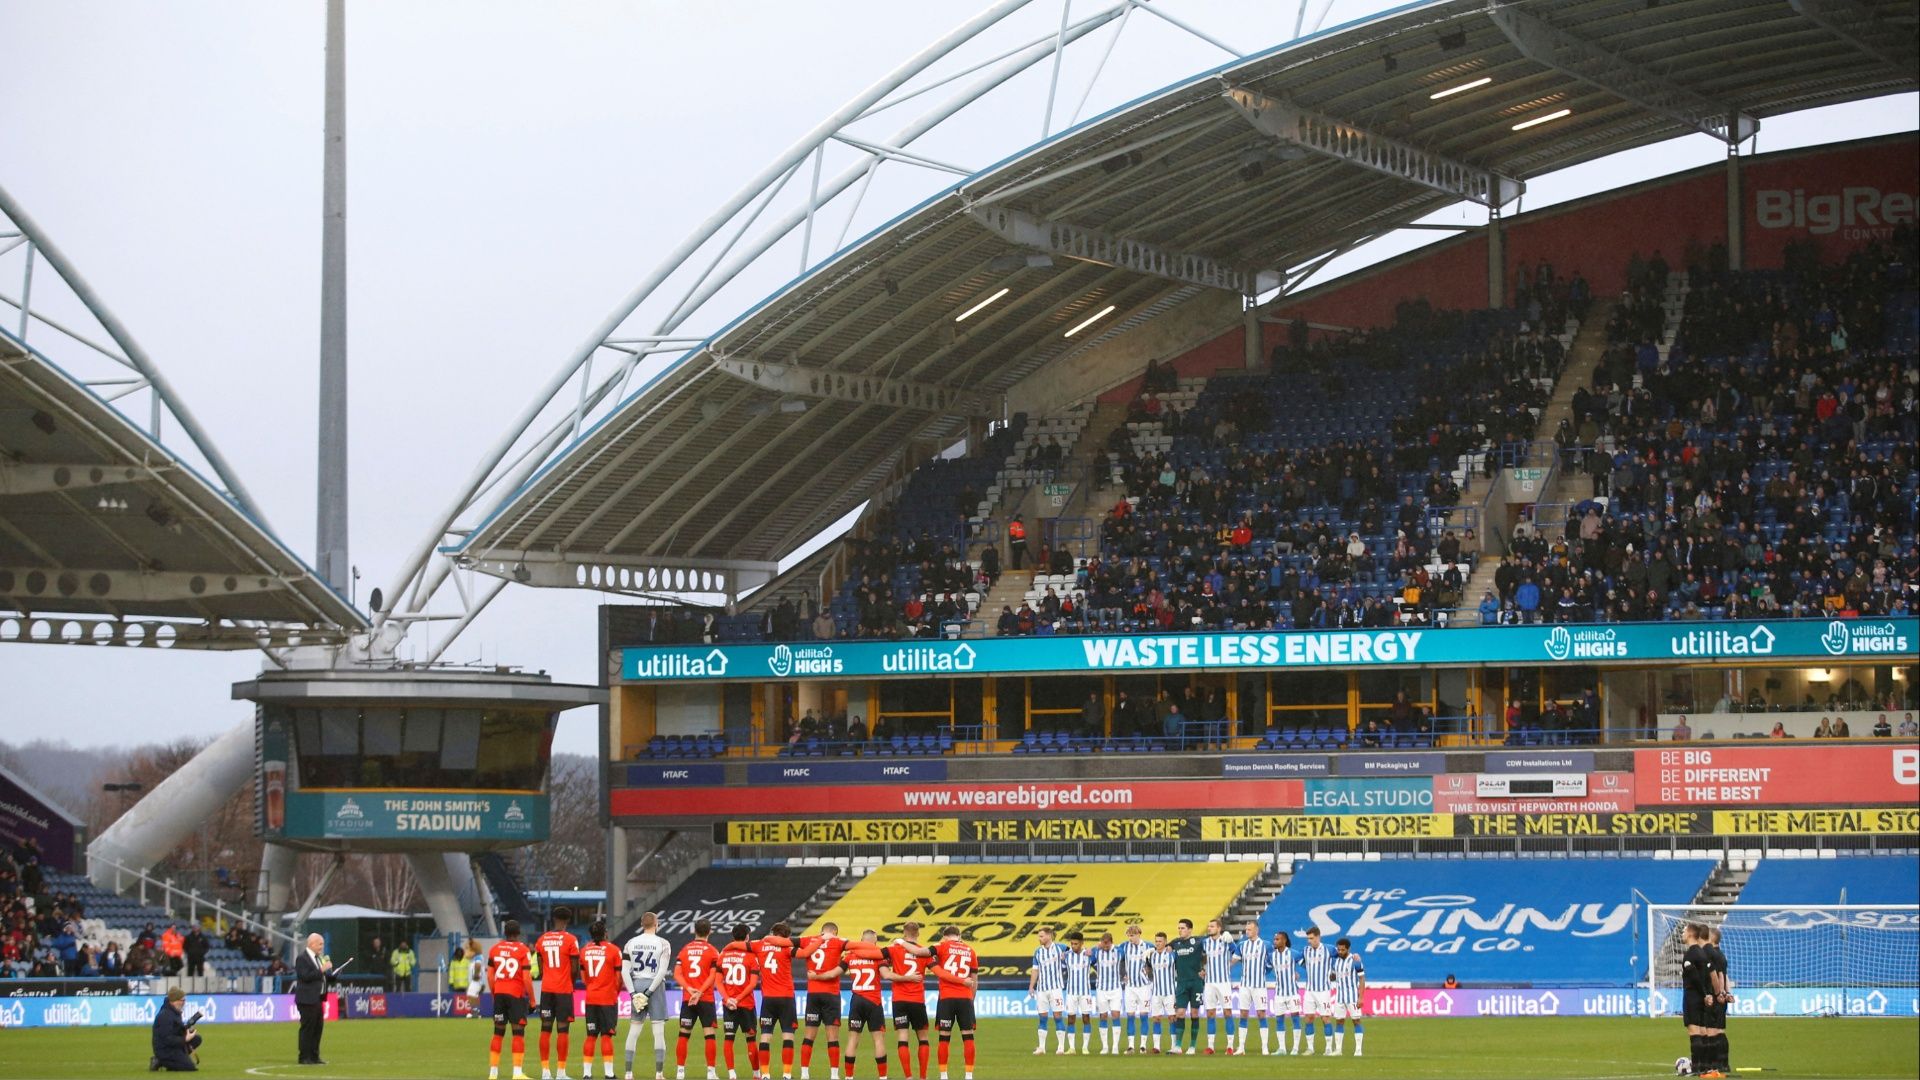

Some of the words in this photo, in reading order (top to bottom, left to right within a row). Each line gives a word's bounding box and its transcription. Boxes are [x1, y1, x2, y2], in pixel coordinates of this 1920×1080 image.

[1756, 186, 1918, 234] BigRe
[1574, 631, 1606, 641] utilita
[1852, 626, 1884, 636] utilita
[1082, 637, 1198, 667] WASTE
[1204, 636, 1280, 665] LESS
[1285, 632, 1422, 664] ENERGY
[1574, 642, 1613, 657] HIGH
[1617, 642, 1628, 656] 5
[1671, 630, 1750, 655] utilita
[1852, 637, 1893, 651] HIGH
[1895, 636, 1907, 650] 5
[795, 649, 824, 659] utilita
[883, 649, 951, 672] utilita
[638, 654, 706, 677] utilita
[795, 661, 832, 673] HIGH
[834, 659, 843, 672] 5
[1225, 763, 1251, 772] Simpson
[1275, 763, 1298, 772] Roofing
[1299, 762, 1325, 771] Services
[1376, 762, 1406, 771] Packaging
[1522, 759, 1561, 767] Installations
[1661, 752, 1681, 765] BE
[1684, 751, 1712, 765] BIG
[662, 770, 689, 779] HTAFC
[783, 768, 810, 777] HTAFC
[883, 766, 910, 776] HTAFC
[1661, 769, 1681, 783] BE
[1684, 767, 1771, 783] DIFFERENT
[904, 785, 1133, 808] www.wearebigred.com
[1304, 790, 1360, 807] LEGAL
[1364, 789, 1433, 806] STUDIO
[1661, 787, 1681, 801] BE
[1684, 787, 1717, 801] THE
[1720, 786, 1762, 800] BEST
[384, 800, 408, 811] THE
[410, 800, 442, 811] JOHN
[445, 801, 491, 812] SMITH'S
[1448, 803, 1473, 812] TIME
[1475, 803, 1489, 812] TO
[1490, 802, 1517, 812] VISIT
[1519, 801, 1578, 811] HEPWORTH
[1580, 801, 1618, 811] HONDA
[396, 813, 481, 831] STADIUM
[736, 823, 780, 843] THE
[787, 822, 861, 842] METAL
[973, 820, 1017, 841] THE
[1024, 819, 1102, 841] METAL
[1217, 818, 1263, 838] THE
[1271, 817, 1350, 837] METAL
[1469, 814, 1517, 836] THE
[1524, 814, 1607, 835] METAL
[1729, 813, 1779, 833] THE
[1787, 812, 1871, 833] METAL
[936, 873, 1077, 894] THE
[1342, 888, 1407, 901] The
[897, 896, 1141, 918] METAL
[494, 956, 519, 978] 29
[544, 946, 560, 968] 11
[584, 955, 606, 977] 17
[632, 951, 658, 973] 34
[688, 956, 701, 978] 3
[764, 952, 778, 974] 4
[811, 948, 825, 970] 9
[943, 955, 971, 978] 45
[722, 963, 746, 986] 20
[850, 968, 875, 990] 22
[904, 959, 918, 978] 2
[234, 1000, 265, 1020] utilita
[355, 996, 369, 1014] sky
[371, 997, 385, 1010] bet
[431, 995, 453, 1012] sky
[1372, 994, 1434, 1015] utilita
[1477, 993, 1542, 1014] utilita
[1802, 990, 1865, 1013] utilita
[43, 1003, 79, 1024] utilita
[110, 1002, 144, 1023] utilita
